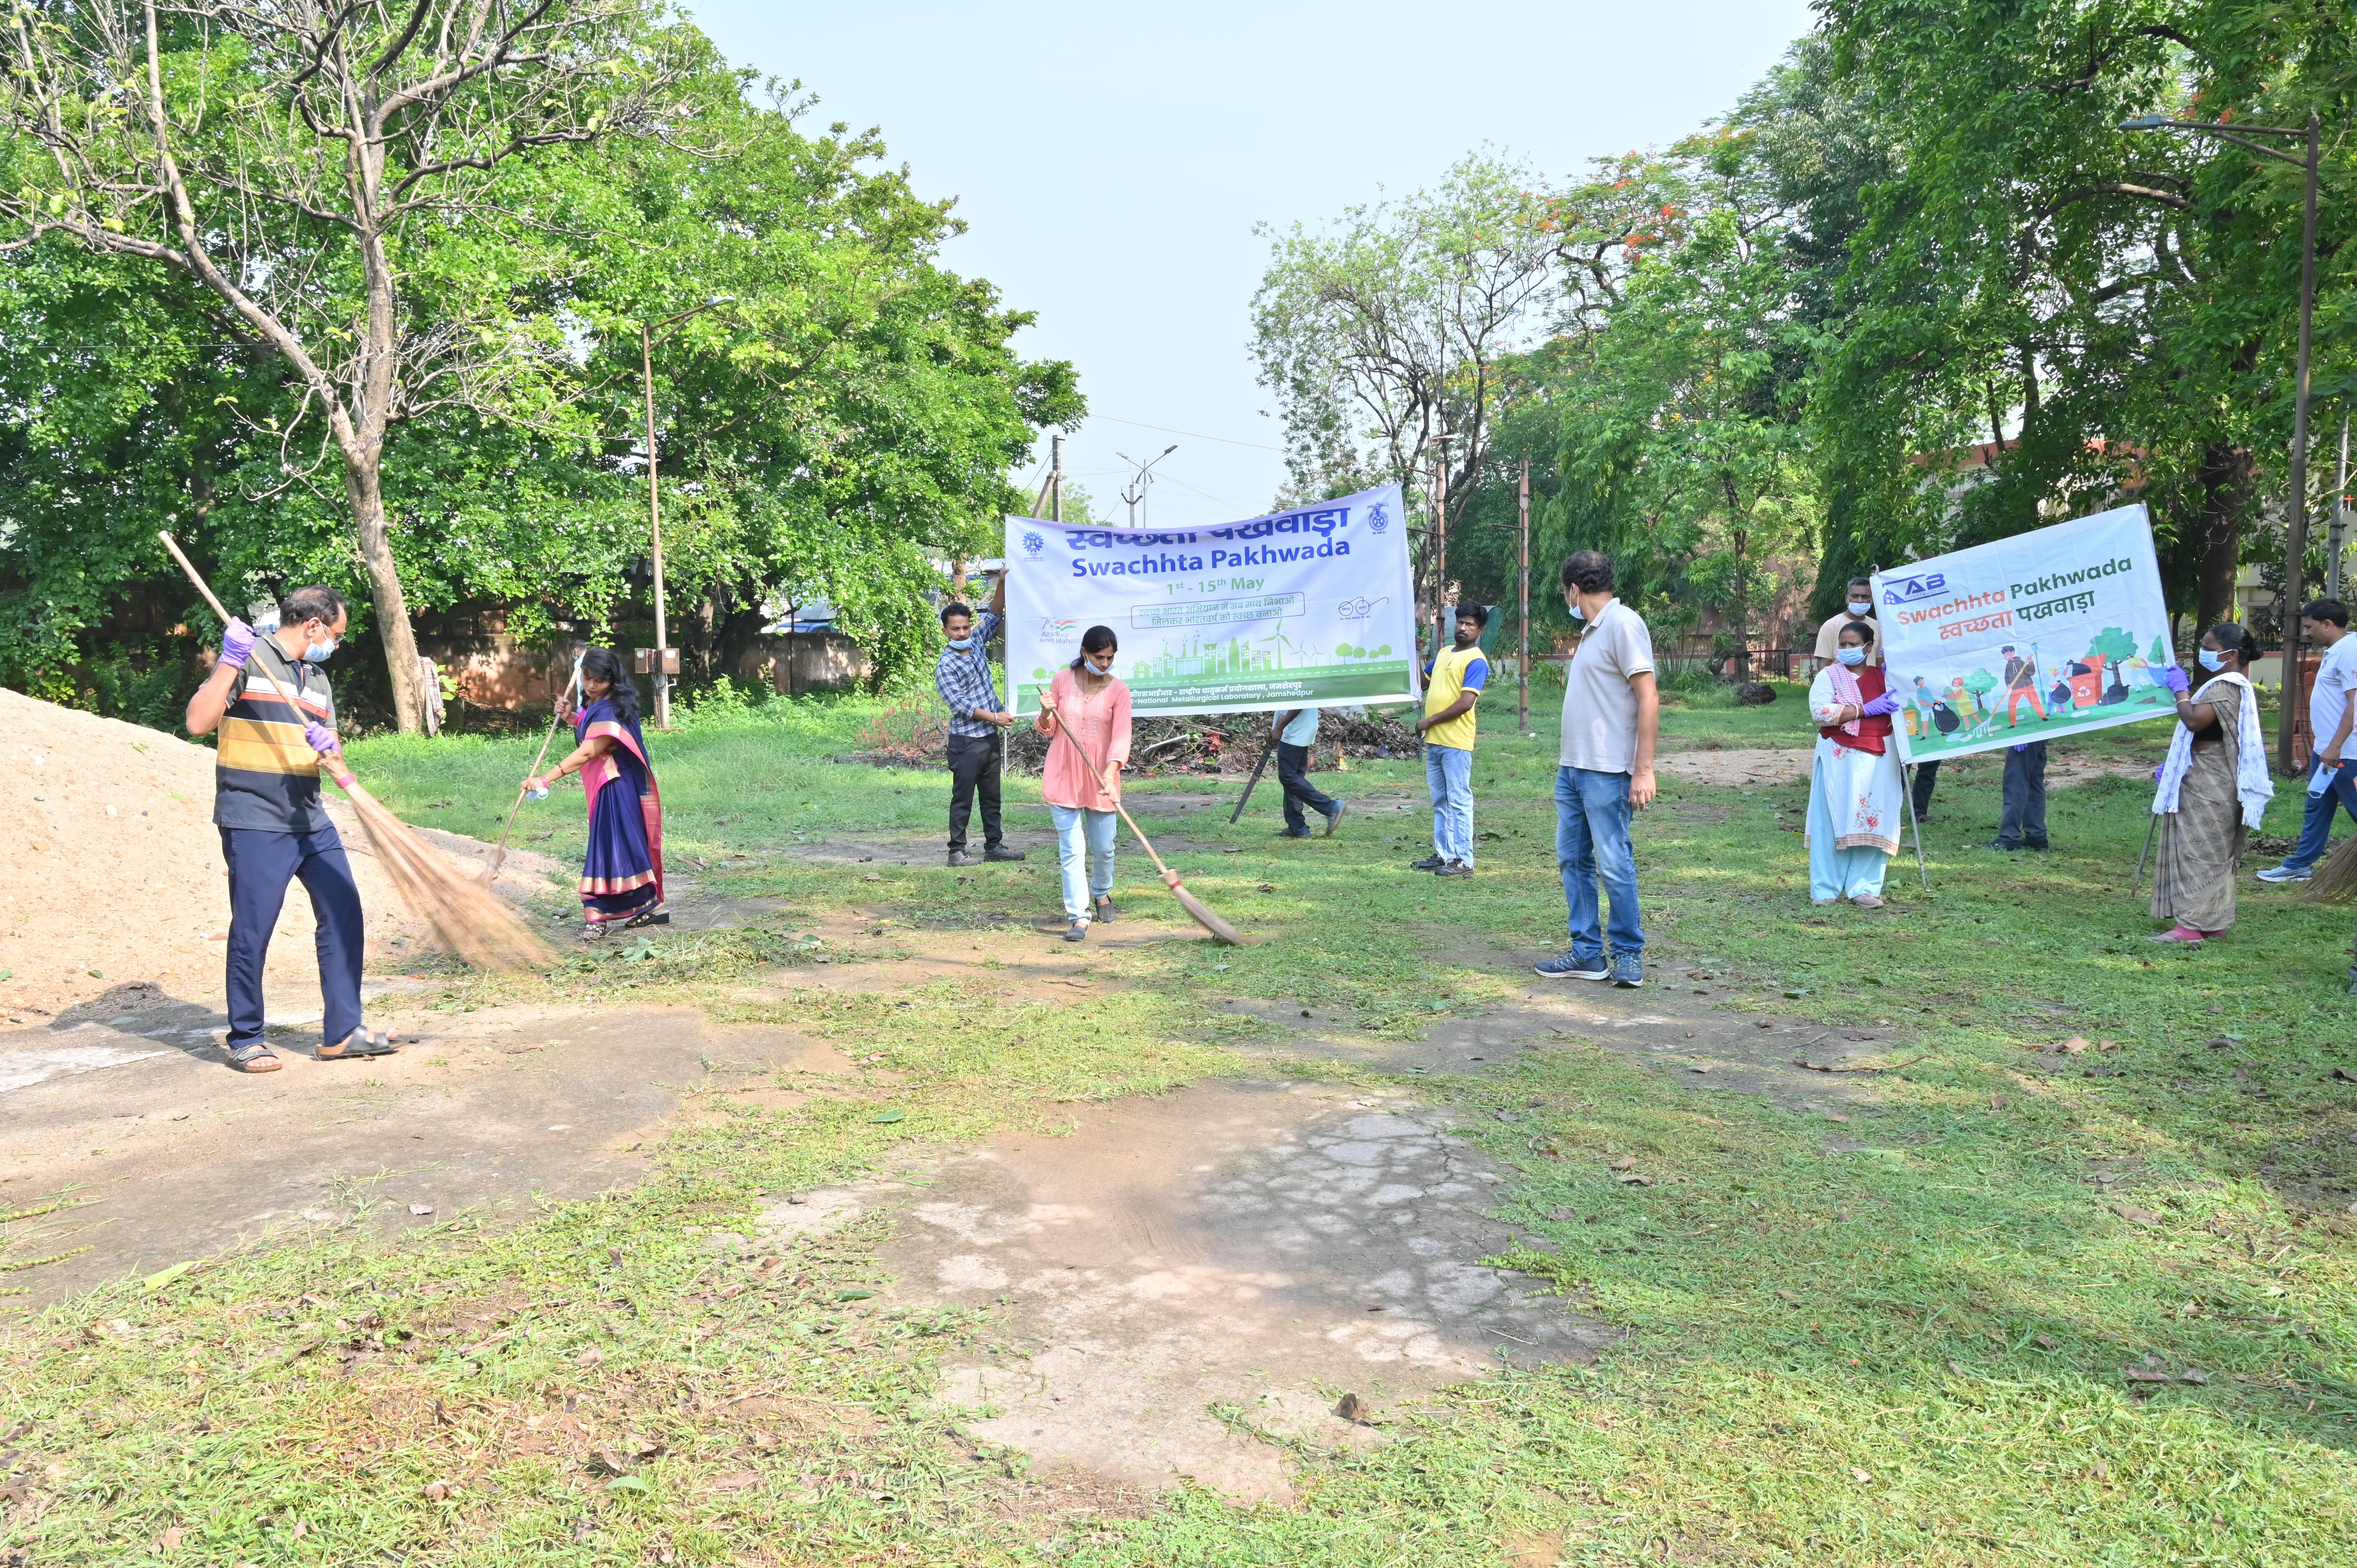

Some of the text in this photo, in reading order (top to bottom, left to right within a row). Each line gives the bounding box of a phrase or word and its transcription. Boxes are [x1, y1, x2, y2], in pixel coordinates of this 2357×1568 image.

[1072, 537, 1350, 577] Swachhta Pakhwada
[1167, 582, 1184, 595] 1st
[1198, 578, 1226, 593] 15th
[1231, 577, 1264, 592] May
[1898, 558, 2132, 625] Swachhta Pakhwada
[1905, 573, 1945, 595] AB
[1905, 587, 1947, 600] CONSTRUCTION
[1186, 603, 1219, 613] अभियान
[1245, 600, 1262, 608] साथ
[1263, 595, 1294, 607] निभाओ
[1152, 607, 1282, 626] मिलकर भारतवर्ष को स्वच्छ बनाओ
[1938, 590, 2095, 640] स्वच्छता पखवाड़ा
[1171, 694, 1219, 703] Metallurgical
[1266, 689, 1313, 697] Jamshedpur
[1179, 687, 1201, 695] राष्ट्रीय
[1202, 685, 1229, 695] धातुकर्म
[1269, 681, 1302, 690] जमशेदपुर
